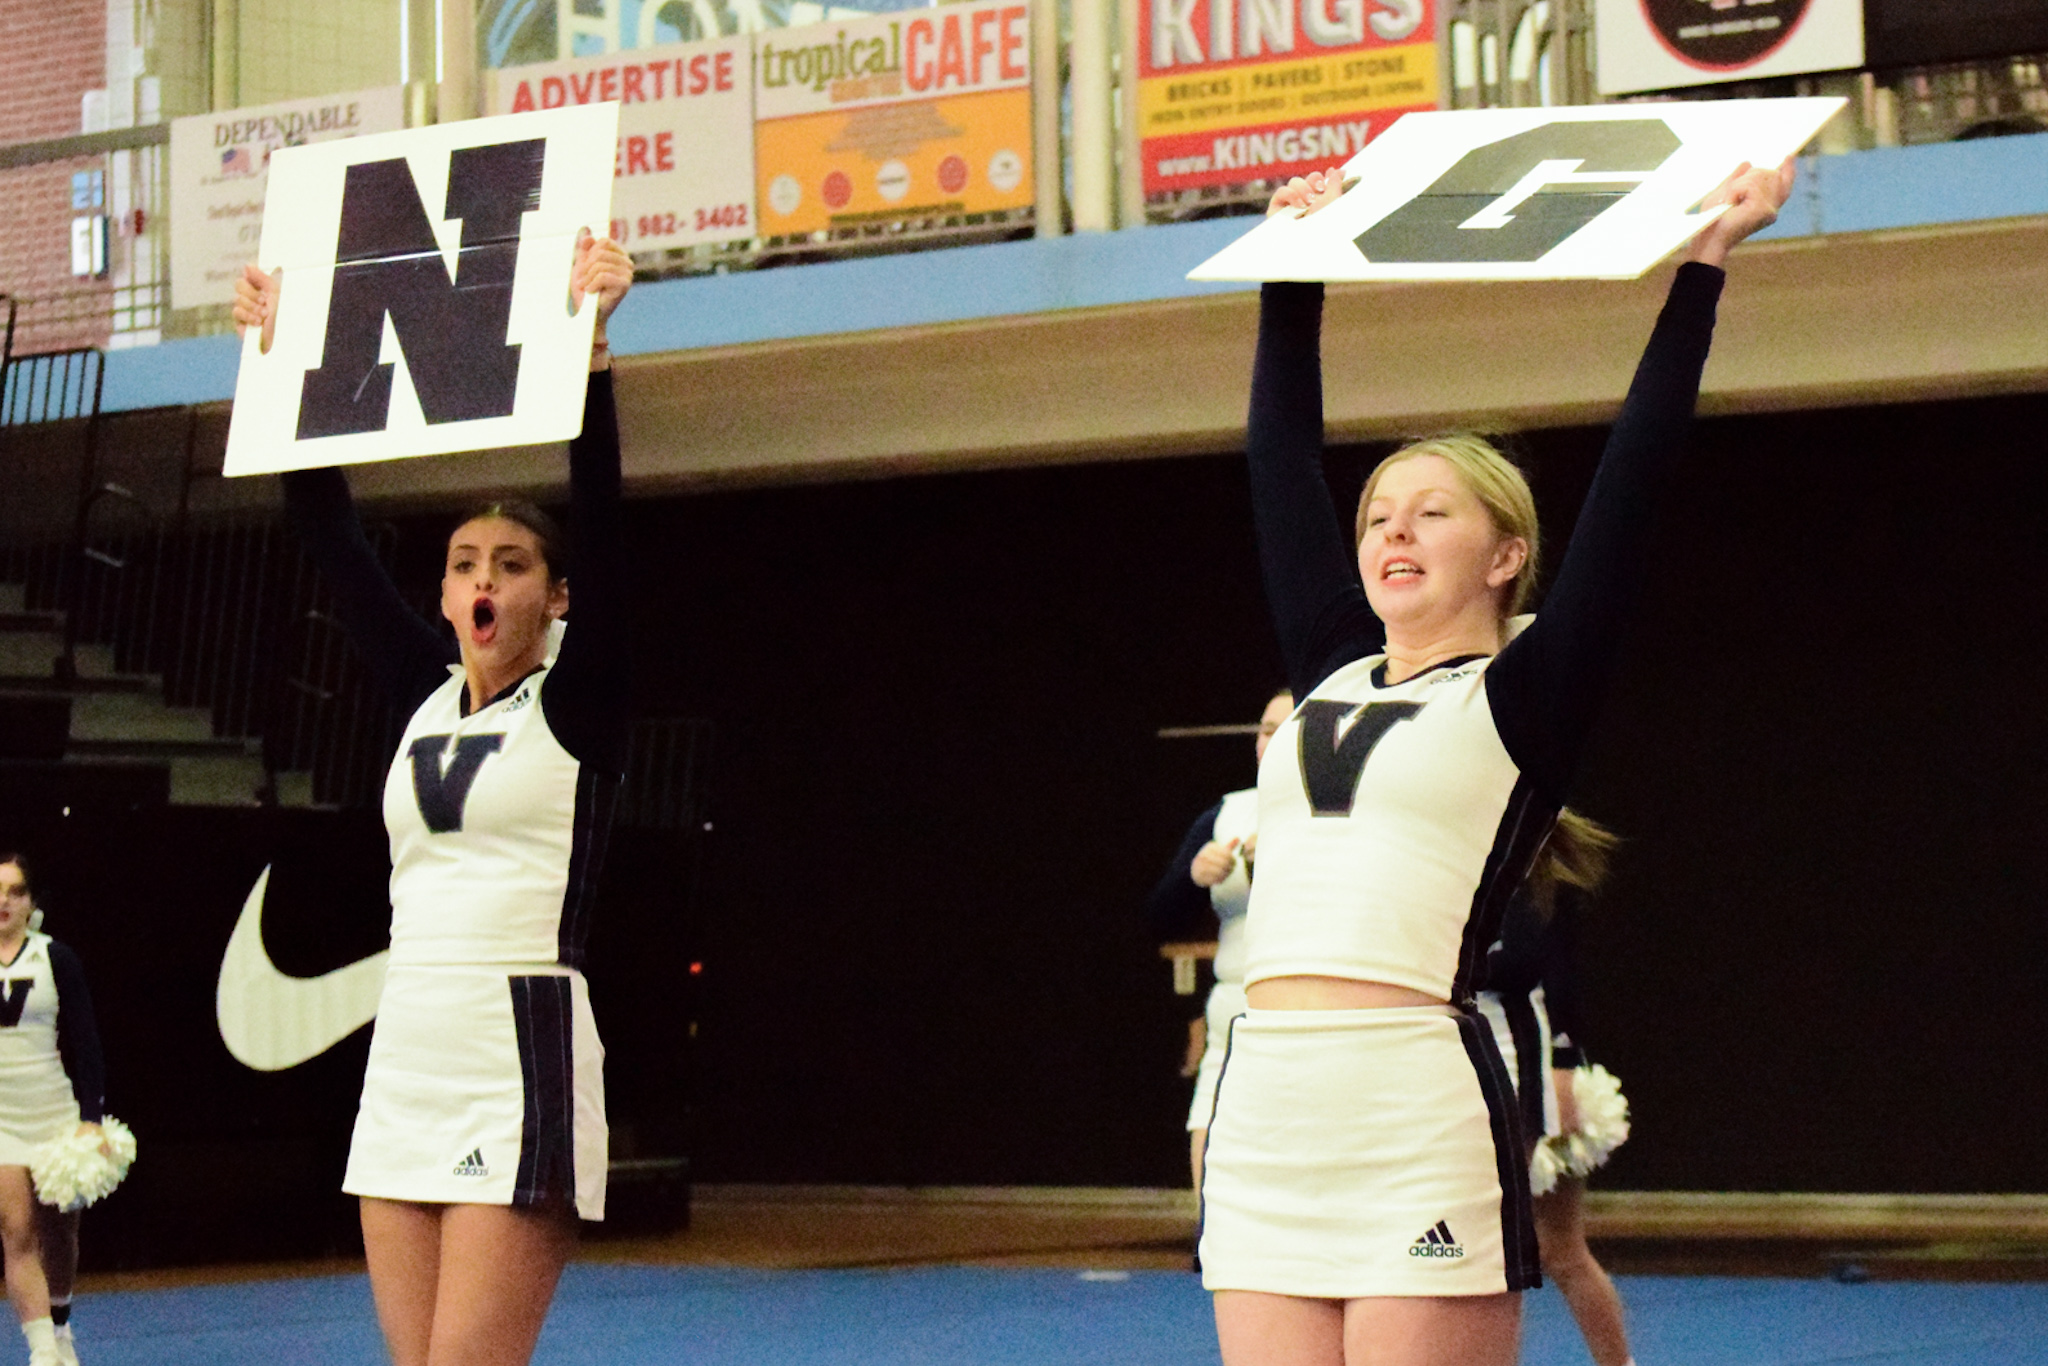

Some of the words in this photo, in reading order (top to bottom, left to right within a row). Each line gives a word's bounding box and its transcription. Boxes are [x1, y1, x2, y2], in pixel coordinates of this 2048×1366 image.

[510, 52, 735, 115] ADVERTISE
[762, 22, 901, 92] tropical
[906, 5, 1026, 92] CAFE
[214, 102, 361, 148] DEPENDABLE
[1352, 118, 1684, 263] G
[295, 136, 548, 441] N
[406, 731, 507, 835] V
[1292, 698, 1428, 818] V
[0, 977, 34, 1028] V
[453, 1165, 489, 1177] adidas
[1408, 1243, 1464, 1258] adidas
